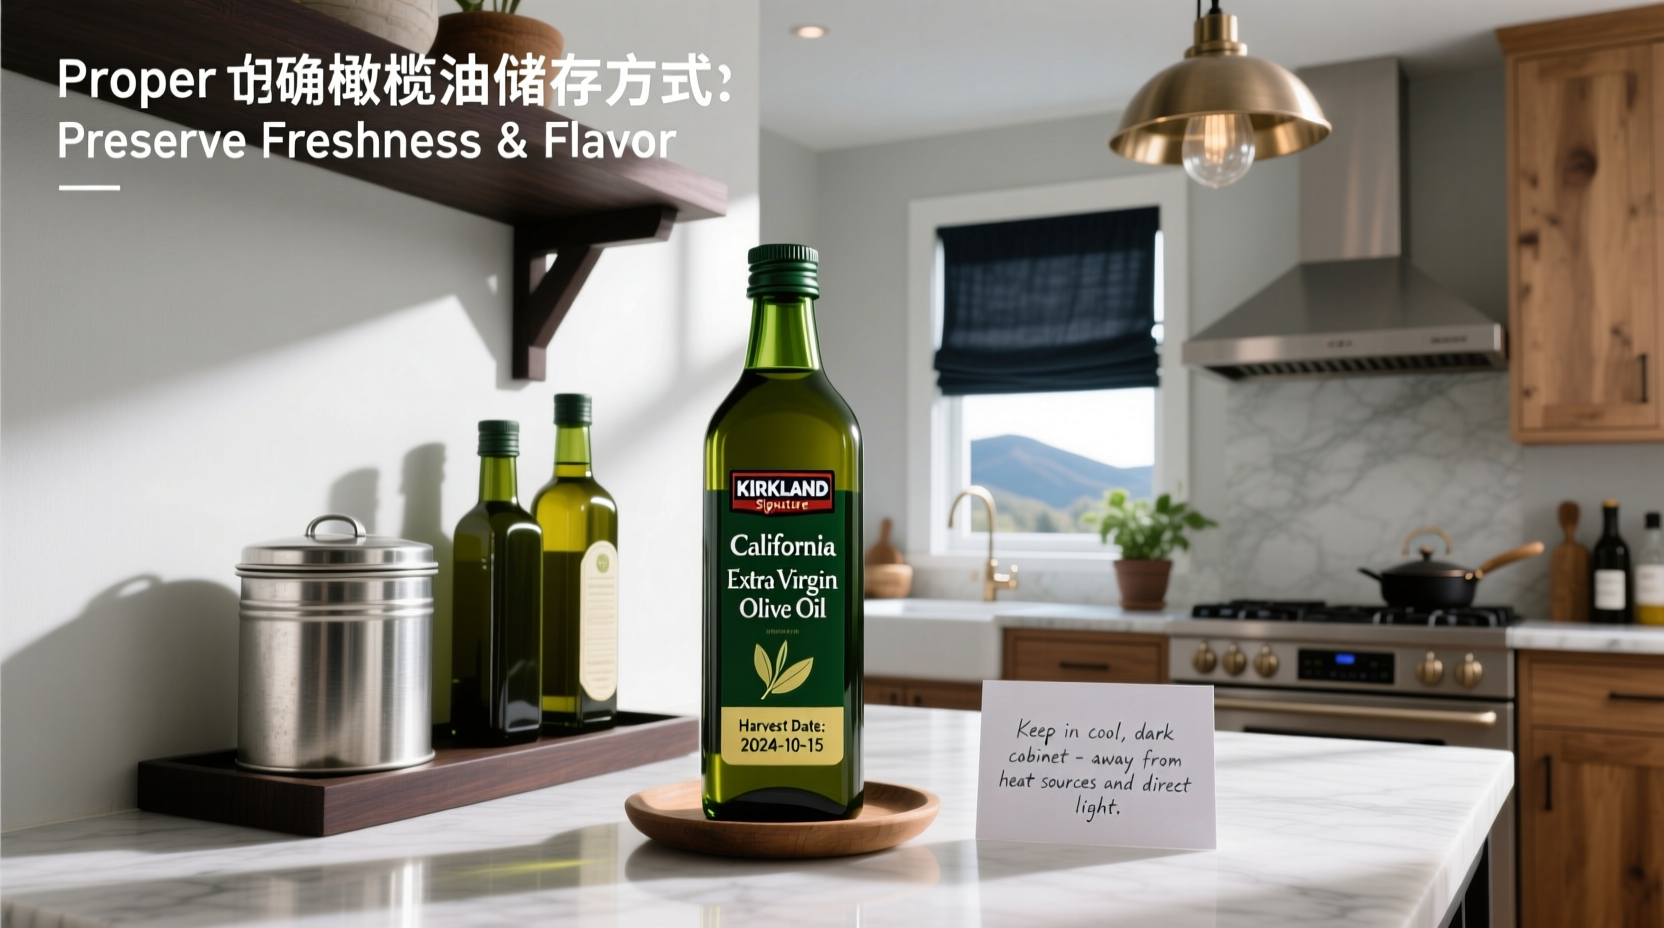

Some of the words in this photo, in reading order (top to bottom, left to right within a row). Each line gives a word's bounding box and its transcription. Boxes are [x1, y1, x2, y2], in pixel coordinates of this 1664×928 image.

[737, 479, 829, 497] KIRKLAND
[730, 533, 837, 556] California
[727, 568, 775, 590] Extra
[777, 569, 838, 596] Virgin
[739, 598, 791, 618] Olive
[796, 597, 826, 618] Oil
[739, 719, 788, 732] Harvest
[791, 719, 825, 732] Date:
[1017, 718, 1056, 745] Keep
[1064, 723, 1079, 738] in
[1088, 722, 1126, 743] cool,
[1135, 722, 1174, 741] dark
[741, 738, 824, 752] 2024-10-15
[1091, 753, 1134, 774] away
[1143, 750, 1182, 769] from
[999, 770, 1035, 788] heat
[1040, 777, 1096, 789] sources
[1104, 774, 1134, 790] and
[1142, 774, 1192, 793] direct
[1076, 795, 1120, 822] light.
